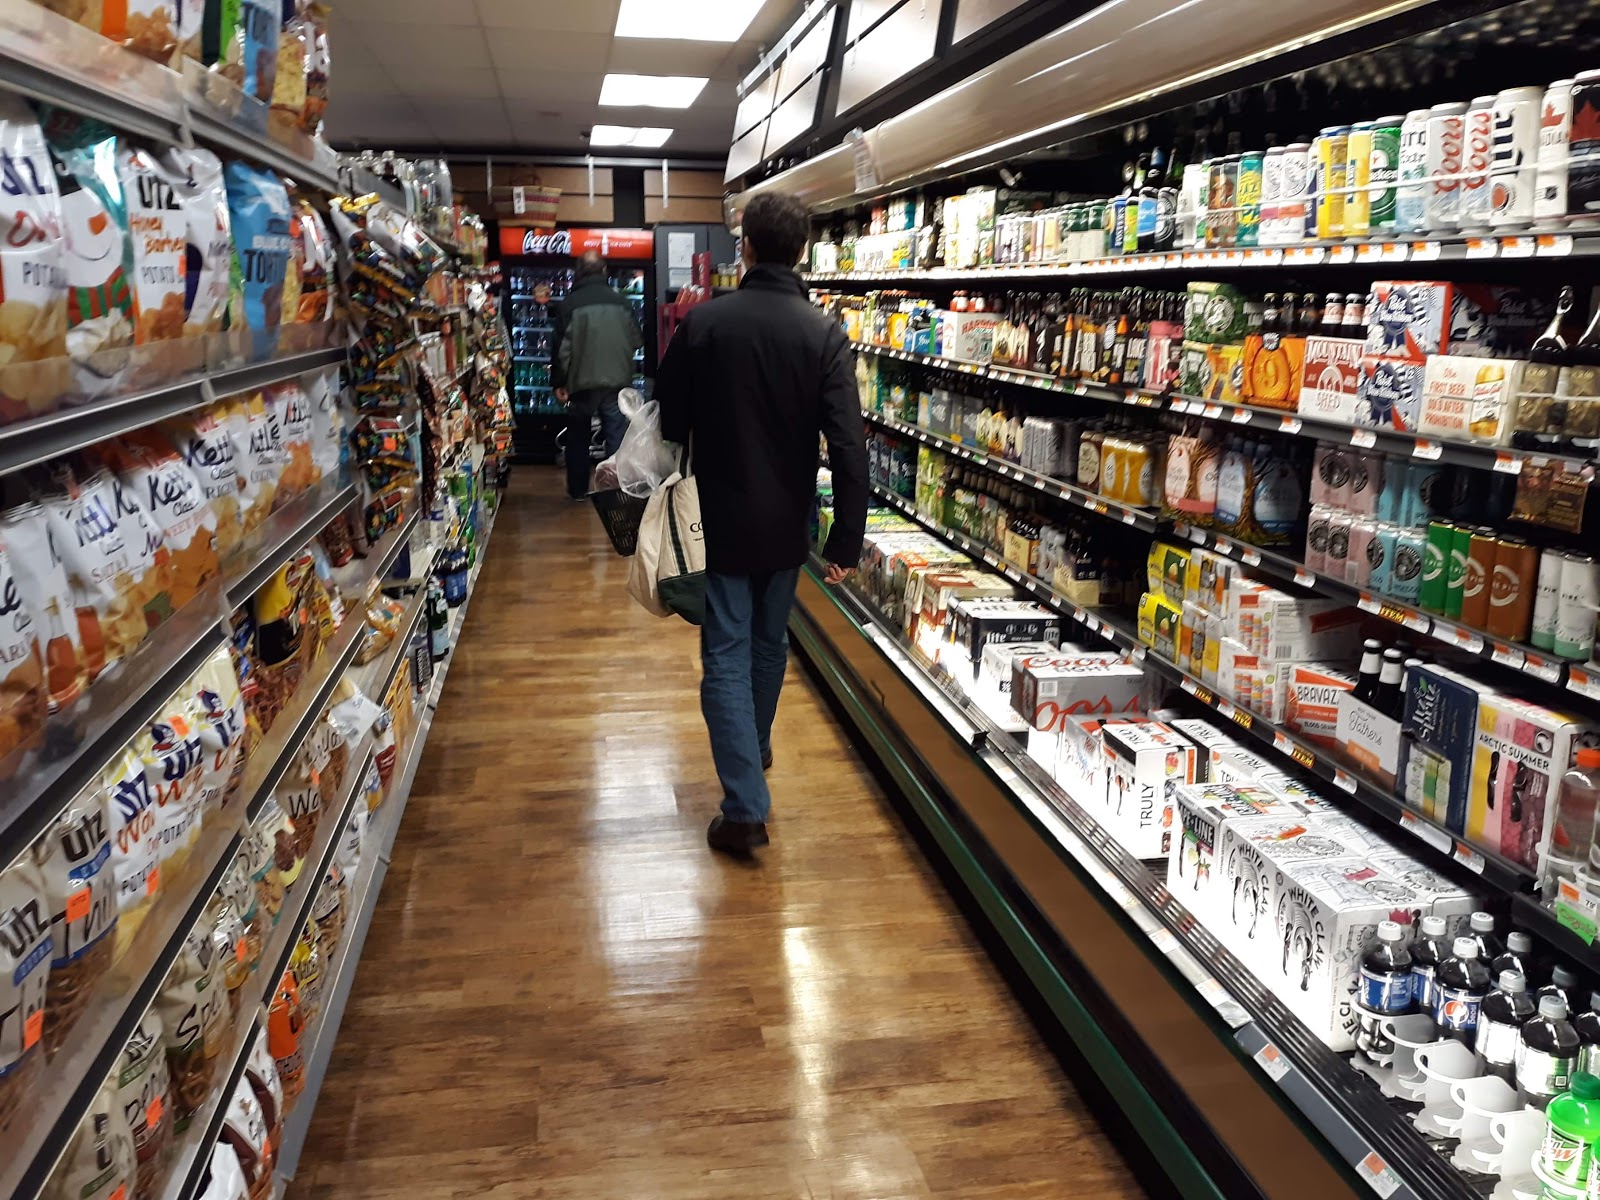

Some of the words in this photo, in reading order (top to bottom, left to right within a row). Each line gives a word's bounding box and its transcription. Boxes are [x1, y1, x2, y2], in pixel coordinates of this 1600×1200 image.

[1297, 686, 1340, 705] BRAVAZ
[1478, 733, 1507, 754] ARCTIC
[1508, 746, 1551, 772] SUMMER
[1140, 783, 1154, 829] TRULY
[1237, 843, 1265, 872] WHITE
[1259, 874, 1270, 918] CLAW
[1288, 887, 1320, 918] WHITE
[1313, 920, 1325, 970] CLAW
